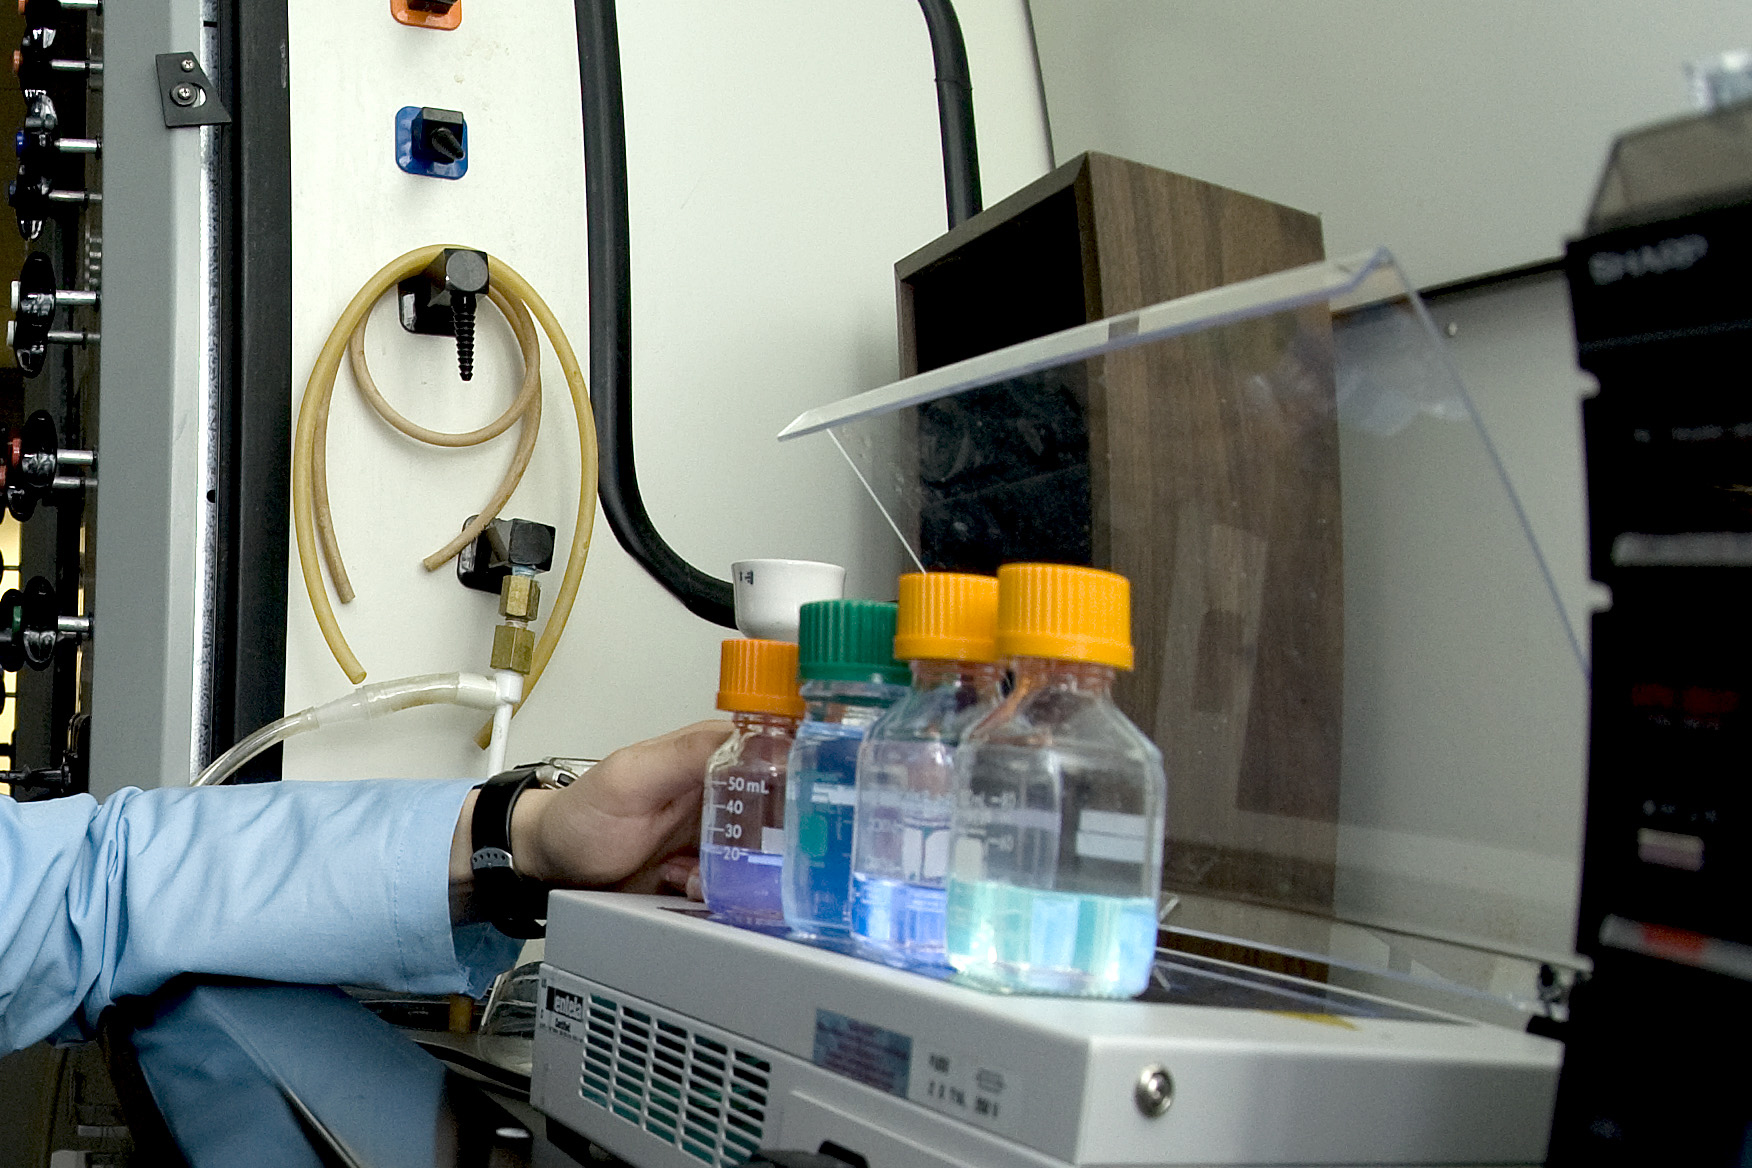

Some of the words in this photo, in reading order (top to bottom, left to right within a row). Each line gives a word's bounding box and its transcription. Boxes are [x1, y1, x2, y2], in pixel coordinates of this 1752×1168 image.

[727, 777, 745, 791] 50
[746, 779, 769, 794] mL
[726, 800, 744, 814] 40
[725, 824, 742, 838] 30
[723, 847, 740, 861] 20
